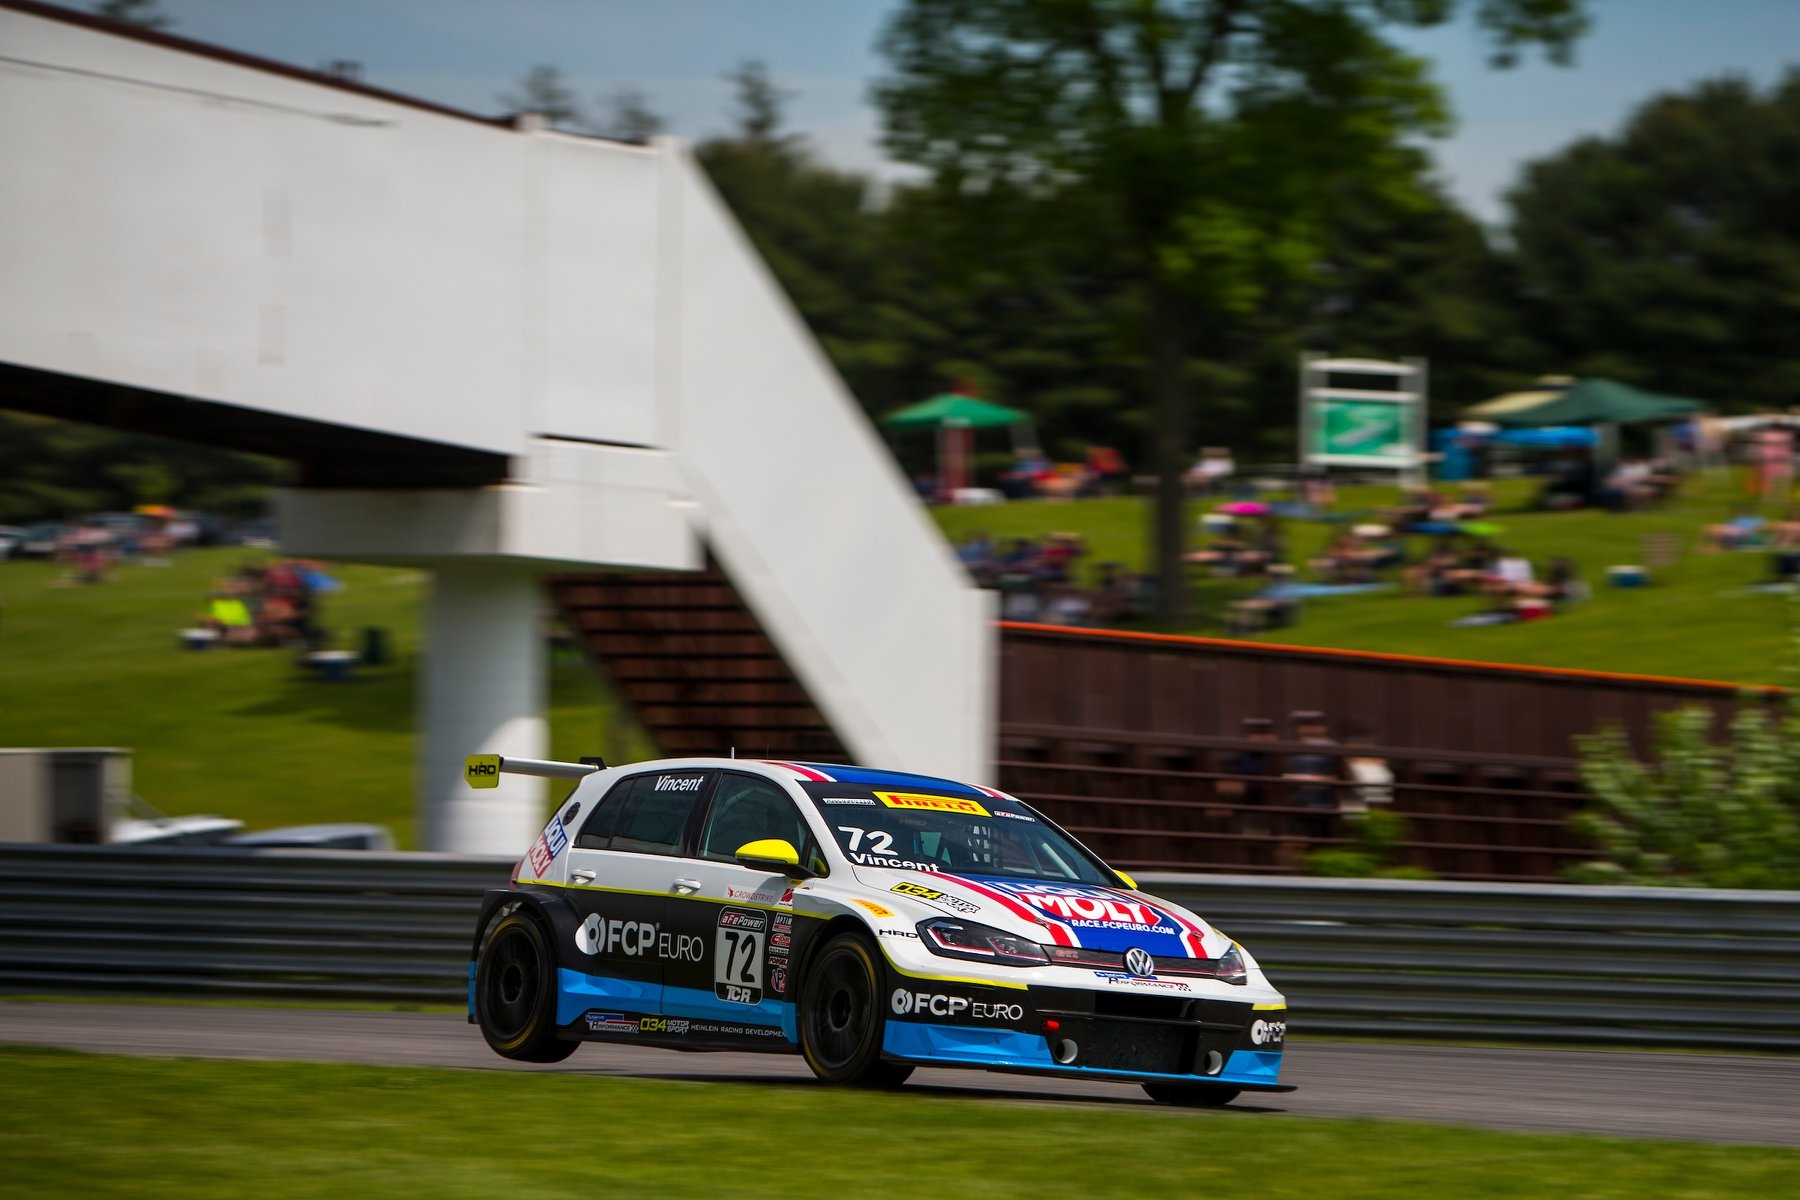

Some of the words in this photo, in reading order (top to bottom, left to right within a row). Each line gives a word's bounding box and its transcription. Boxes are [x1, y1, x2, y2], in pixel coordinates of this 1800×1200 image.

[468, 764, 496, 775] HRD
[655, 775, 704, 791] Vincent
[887, 794, 978, 813] PIRELLI
[545, 817, 566, 857] LIQUI
[837, 826, 898, 856] 72
[849, 852, 940, 873] Vincent
[733, 891, 774, 903] CROWDSTRIKE
[891, 882, 942, 899] 034
[997, 881, 1130, 903] LIQUI
[1024, 893, 1148, 924] MOLY
[776, 915, 793, 925] OPTIM
[1072, 919, 1175, 935] RACE.FCPEURO.COM
[607, 920, 656, 956] FCP
[658, 932, 704, 962] EURO
[878, 929, 918, 939] HRD
[724, 931, 756, 983] 72
[1108, 977, 1175, 990] PERFORMANCE
[726, 985, 752, 1003] TCR
[914, 992, 969, 1016] FCP
[972, 1002, 1024, 1021] EURO
[592, 1021, 631, 1032] PERFORMANCE
[640, 1017, 667, 1031] 034
[667, 1019, 690, 1027] MOTOR
[667, 1026, 690, 1034] SPORT
[691, 1024, 719, 1032] HEINLEIN
[720, 1026, 744, 1034] RACING
[745, 1028, 787, 1037] DEVELOPMEN
